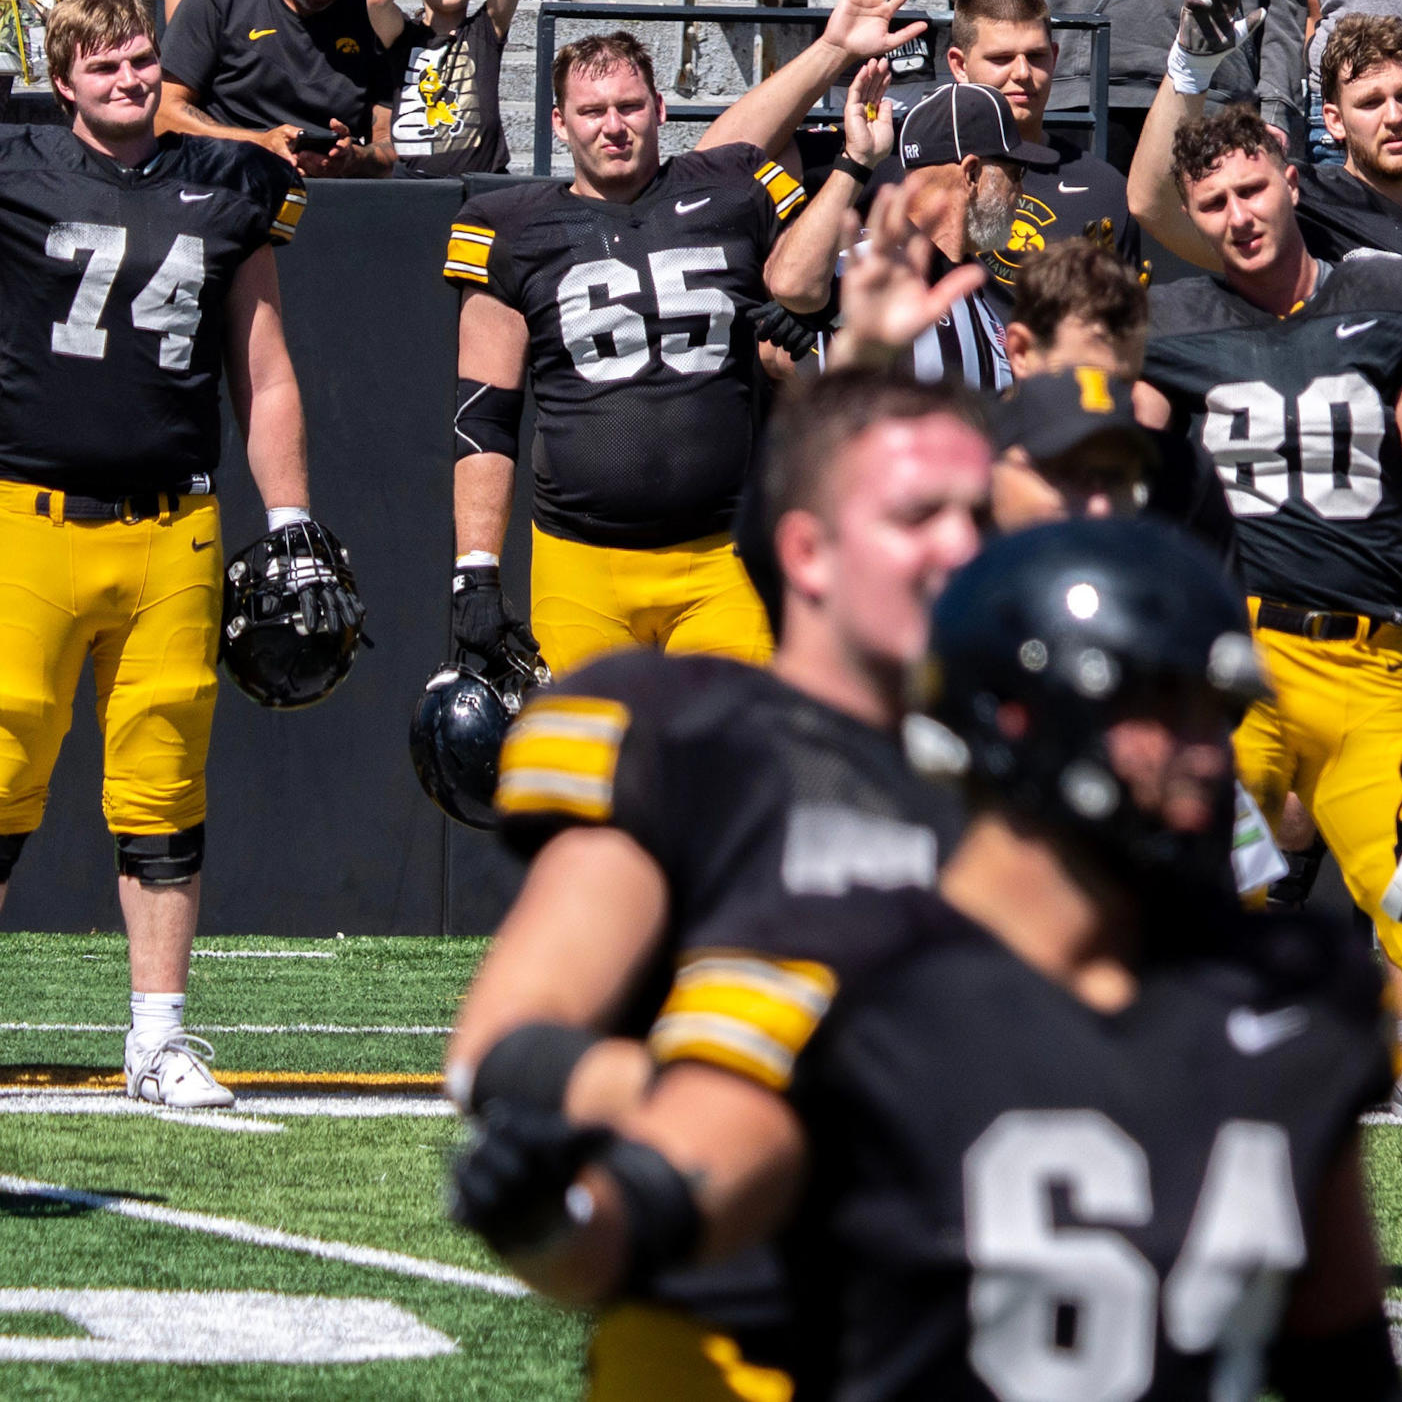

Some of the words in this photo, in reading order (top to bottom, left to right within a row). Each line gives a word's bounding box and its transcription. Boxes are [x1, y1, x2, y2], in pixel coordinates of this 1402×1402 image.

[904, 144, 921, 159] RR
[44, 221, 206, 371] 74
[555, 246, 735, 383] 65
[1203, 371, 1386, 519] 80
[961, 1107, 1308, 1402] 64
